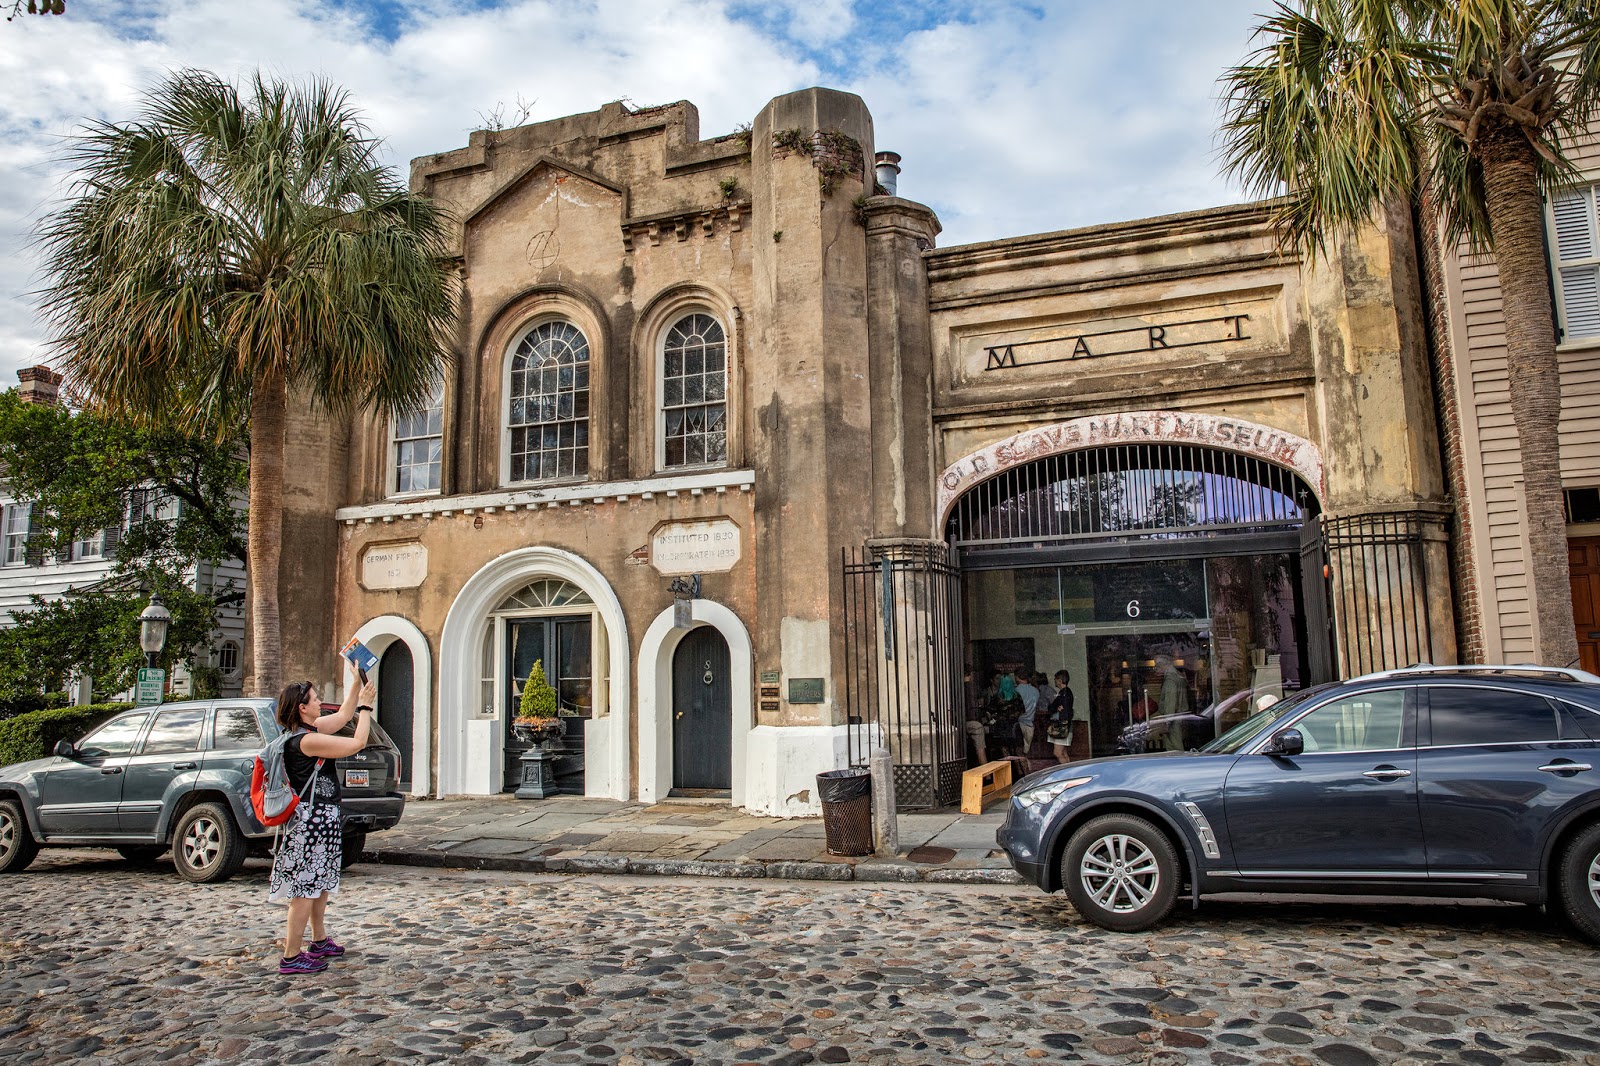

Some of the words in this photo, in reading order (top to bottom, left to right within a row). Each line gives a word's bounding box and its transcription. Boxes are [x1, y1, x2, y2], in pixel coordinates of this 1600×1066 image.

[985, 314, 1250, 371] MART
[994, 424, 1083, 465] SLAVE
[1089, 412, 1166, 443] MART
[1168, 413, 1303, 466] MUSEUM
[660, 533, 709, 545] INSTITUTED
[713, 531, 734, 543] 1830
[366, 554, 393, 564] GERMAN
[1126, 600, 1140, 618] 6
[704, 660, 711, 670] 8
[141, 672, 145, 680] 1
